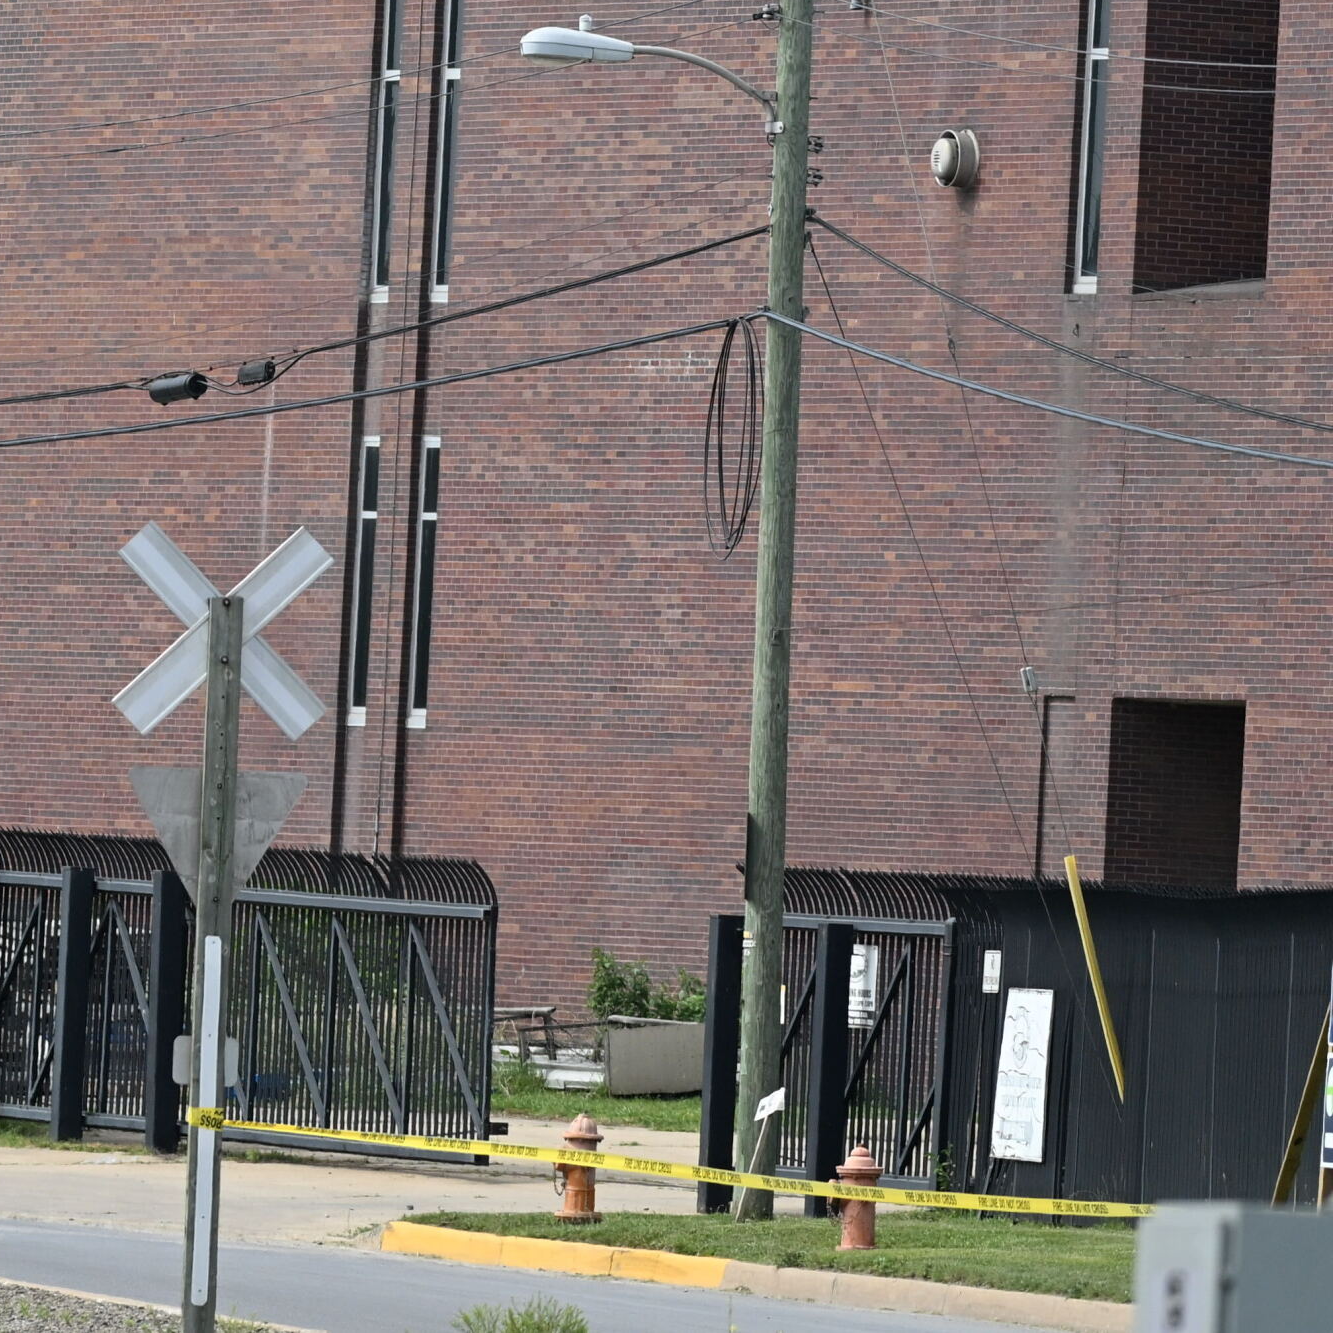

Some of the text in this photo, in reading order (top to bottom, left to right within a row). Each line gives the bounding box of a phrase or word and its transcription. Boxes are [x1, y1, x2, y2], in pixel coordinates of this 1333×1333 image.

[200, 1114, 222, 1129] ROSS
[557, 1150, 605, 1165] FIRE LINE DO NOT CROSS
[624, 1158, 672, 1174] FIRE LINE DO NOT CROSS
[692, 1167, 741, 1184] FIRE LINE DO NOT CROSS
[761, 1177, 813, 1193] FIRE LINE DO NOT CROSS
[833, 1185, 885, 1199] FIRE LINE DO NOT CROSS
[905, 1191, 958, 1206] FIRE LINE DO NOT CROSS
[978, 1196, 1031, 1211] FIRE LINE DO NOT CROSS
[1052, 1201, 1109, 1215] FIRE LINE DO NOT CROSS
